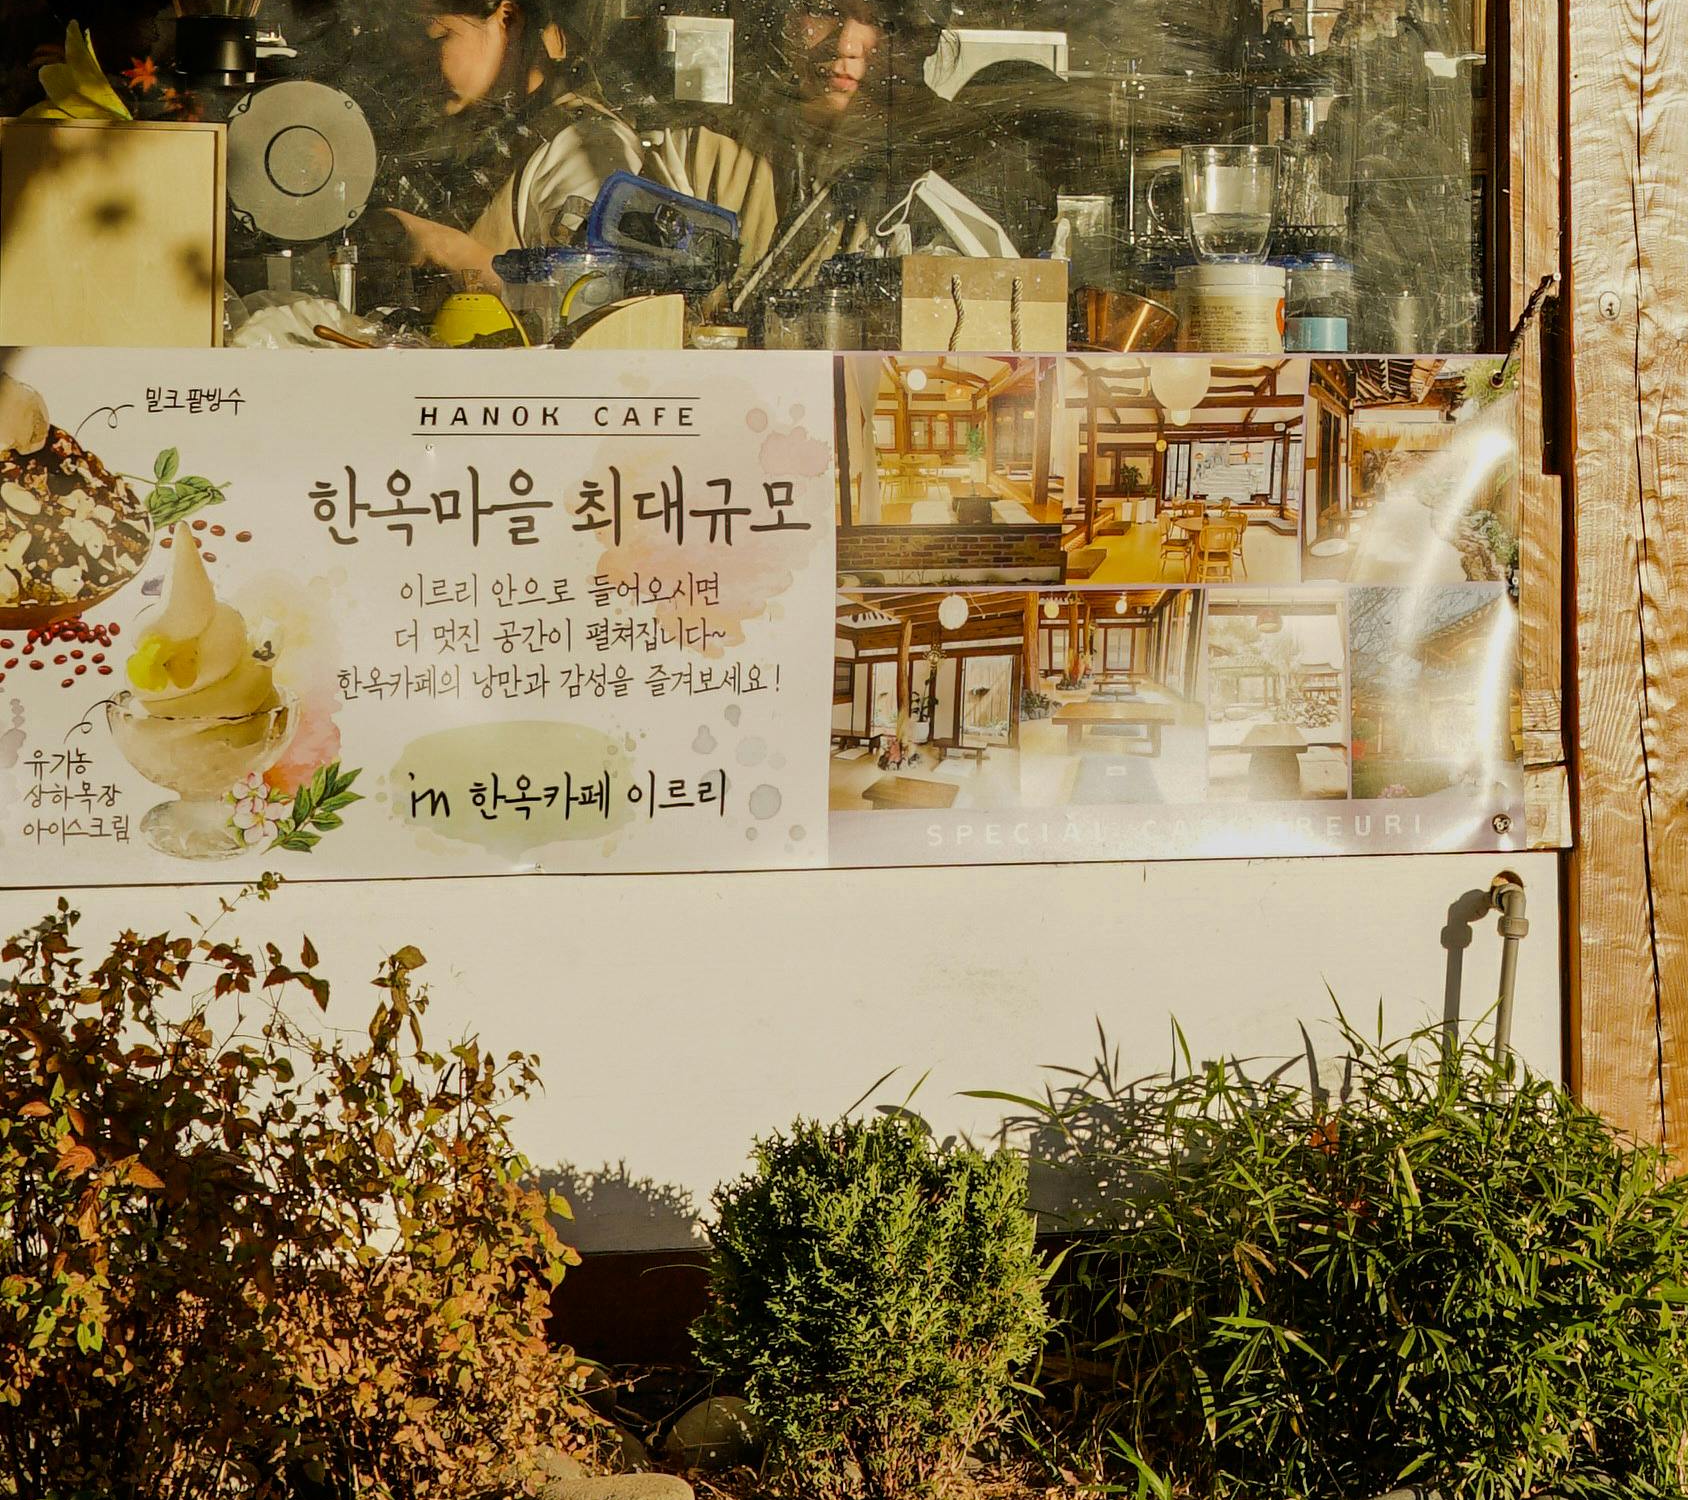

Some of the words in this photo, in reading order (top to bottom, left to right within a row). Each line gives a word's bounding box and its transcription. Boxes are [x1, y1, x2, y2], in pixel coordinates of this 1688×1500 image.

[420, 405, 559, 427] HANOK
[594, 406, 693, 427] CAFE
[307, 464, 554, 548] 한옥마을
[571, 464, 812, 547] 최대규모
[400, 572, 477, 608] 이르리
[491, 573, 576, 608] 안으로
[587, 571, 720, 608] 들어오시면
[395, 618, 418, 653] 더
[433, 618, 480, 654] 멋진
[493, 617, 571, 654] 공간이
[336, 664, 460, 701] 한옥카페의
[473, 663, 551, 699] 낭만과
[560, 662, 634, 699] 감성을
[23, 747, 93, 781] 유기농
[23, 781, 122, 813] 상하목장
[408, 771, 451, 819] in
[468, 769, 610, 821] 한옥카페
[626, 768, 726, 819] 이르리
[23, 814, 130, 846] 아이스크림
